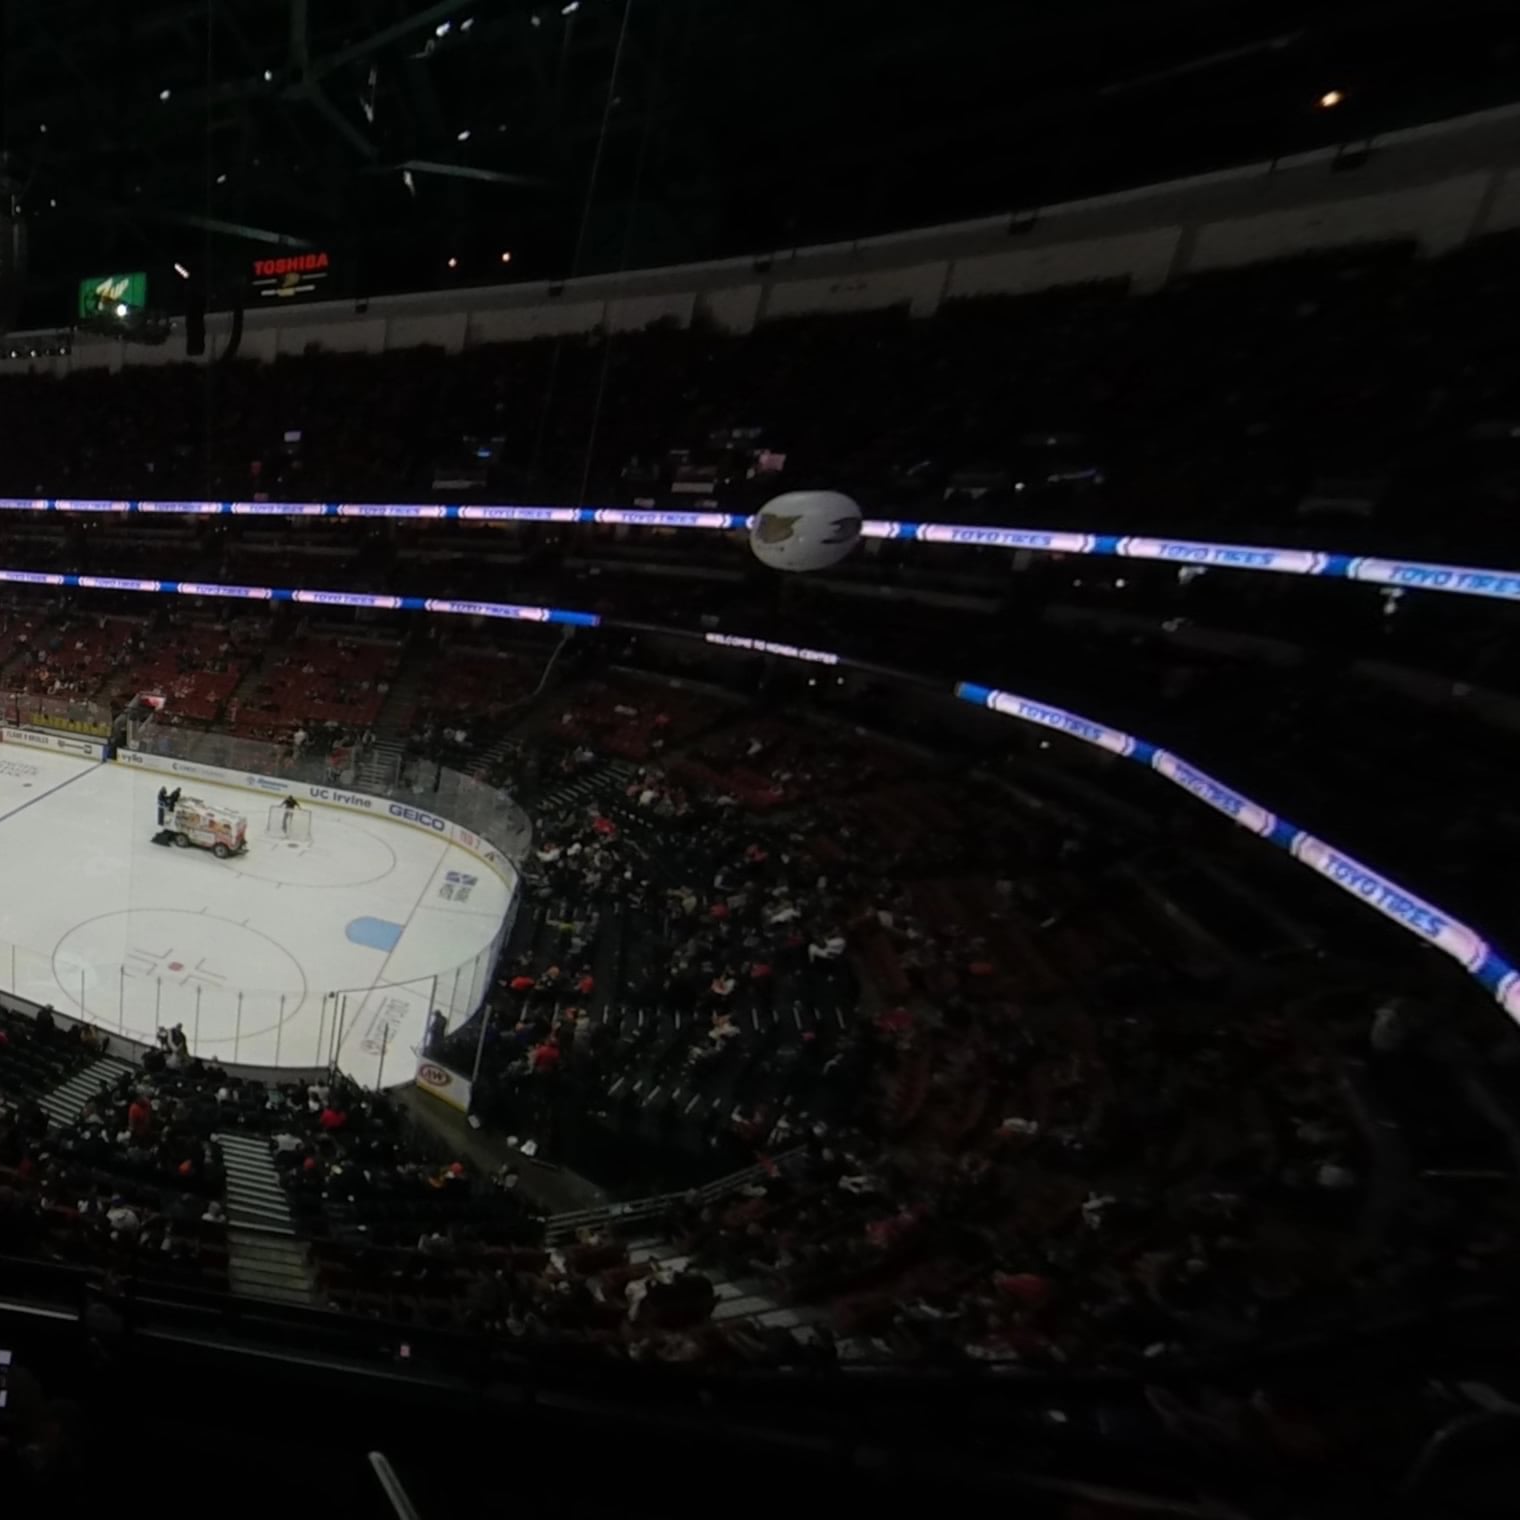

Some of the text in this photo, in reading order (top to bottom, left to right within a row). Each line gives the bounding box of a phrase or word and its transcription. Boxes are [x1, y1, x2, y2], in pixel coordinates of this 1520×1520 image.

[253, 253, 328, 276] TOSHIBA
[951, 528, 1053, 547] TOYO TIRES
[1159, 543, 1276, 566] TOYO TIRES
[1390, 565, 1454, 585] TOYO
[1017, 703, 1104, 741] TOYO TIRES
[310, 787, 372, 808] UC Irvine
[389, 803, 445, 832] GEICO
[1325, 854, 1450, 938] TOYO TIRES
